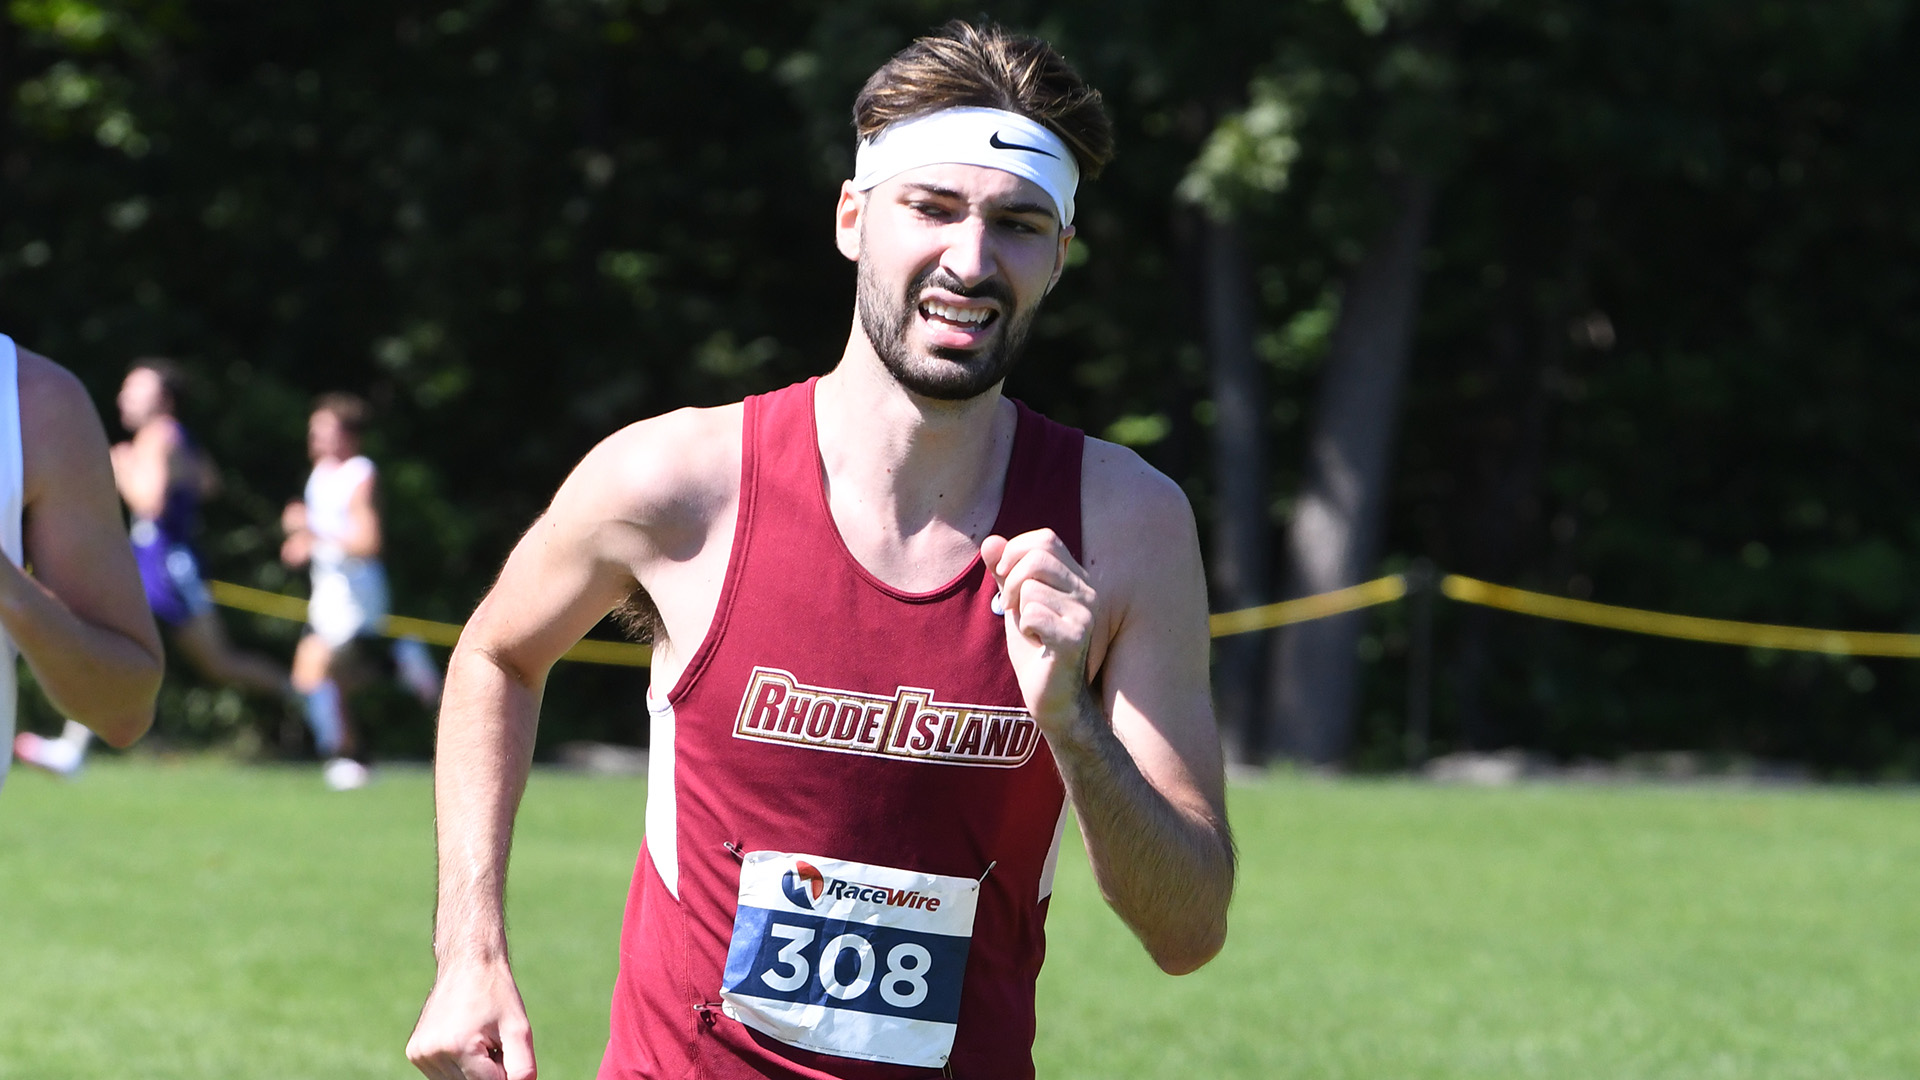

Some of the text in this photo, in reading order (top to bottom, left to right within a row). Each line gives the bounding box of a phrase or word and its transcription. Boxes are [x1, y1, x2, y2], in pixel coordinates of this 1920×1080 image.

[745, 681, 1036, 757] RHODE ISLAND
[827, 878, 941, 912] RaceWire
[760, 922, 932, 1008] 308
